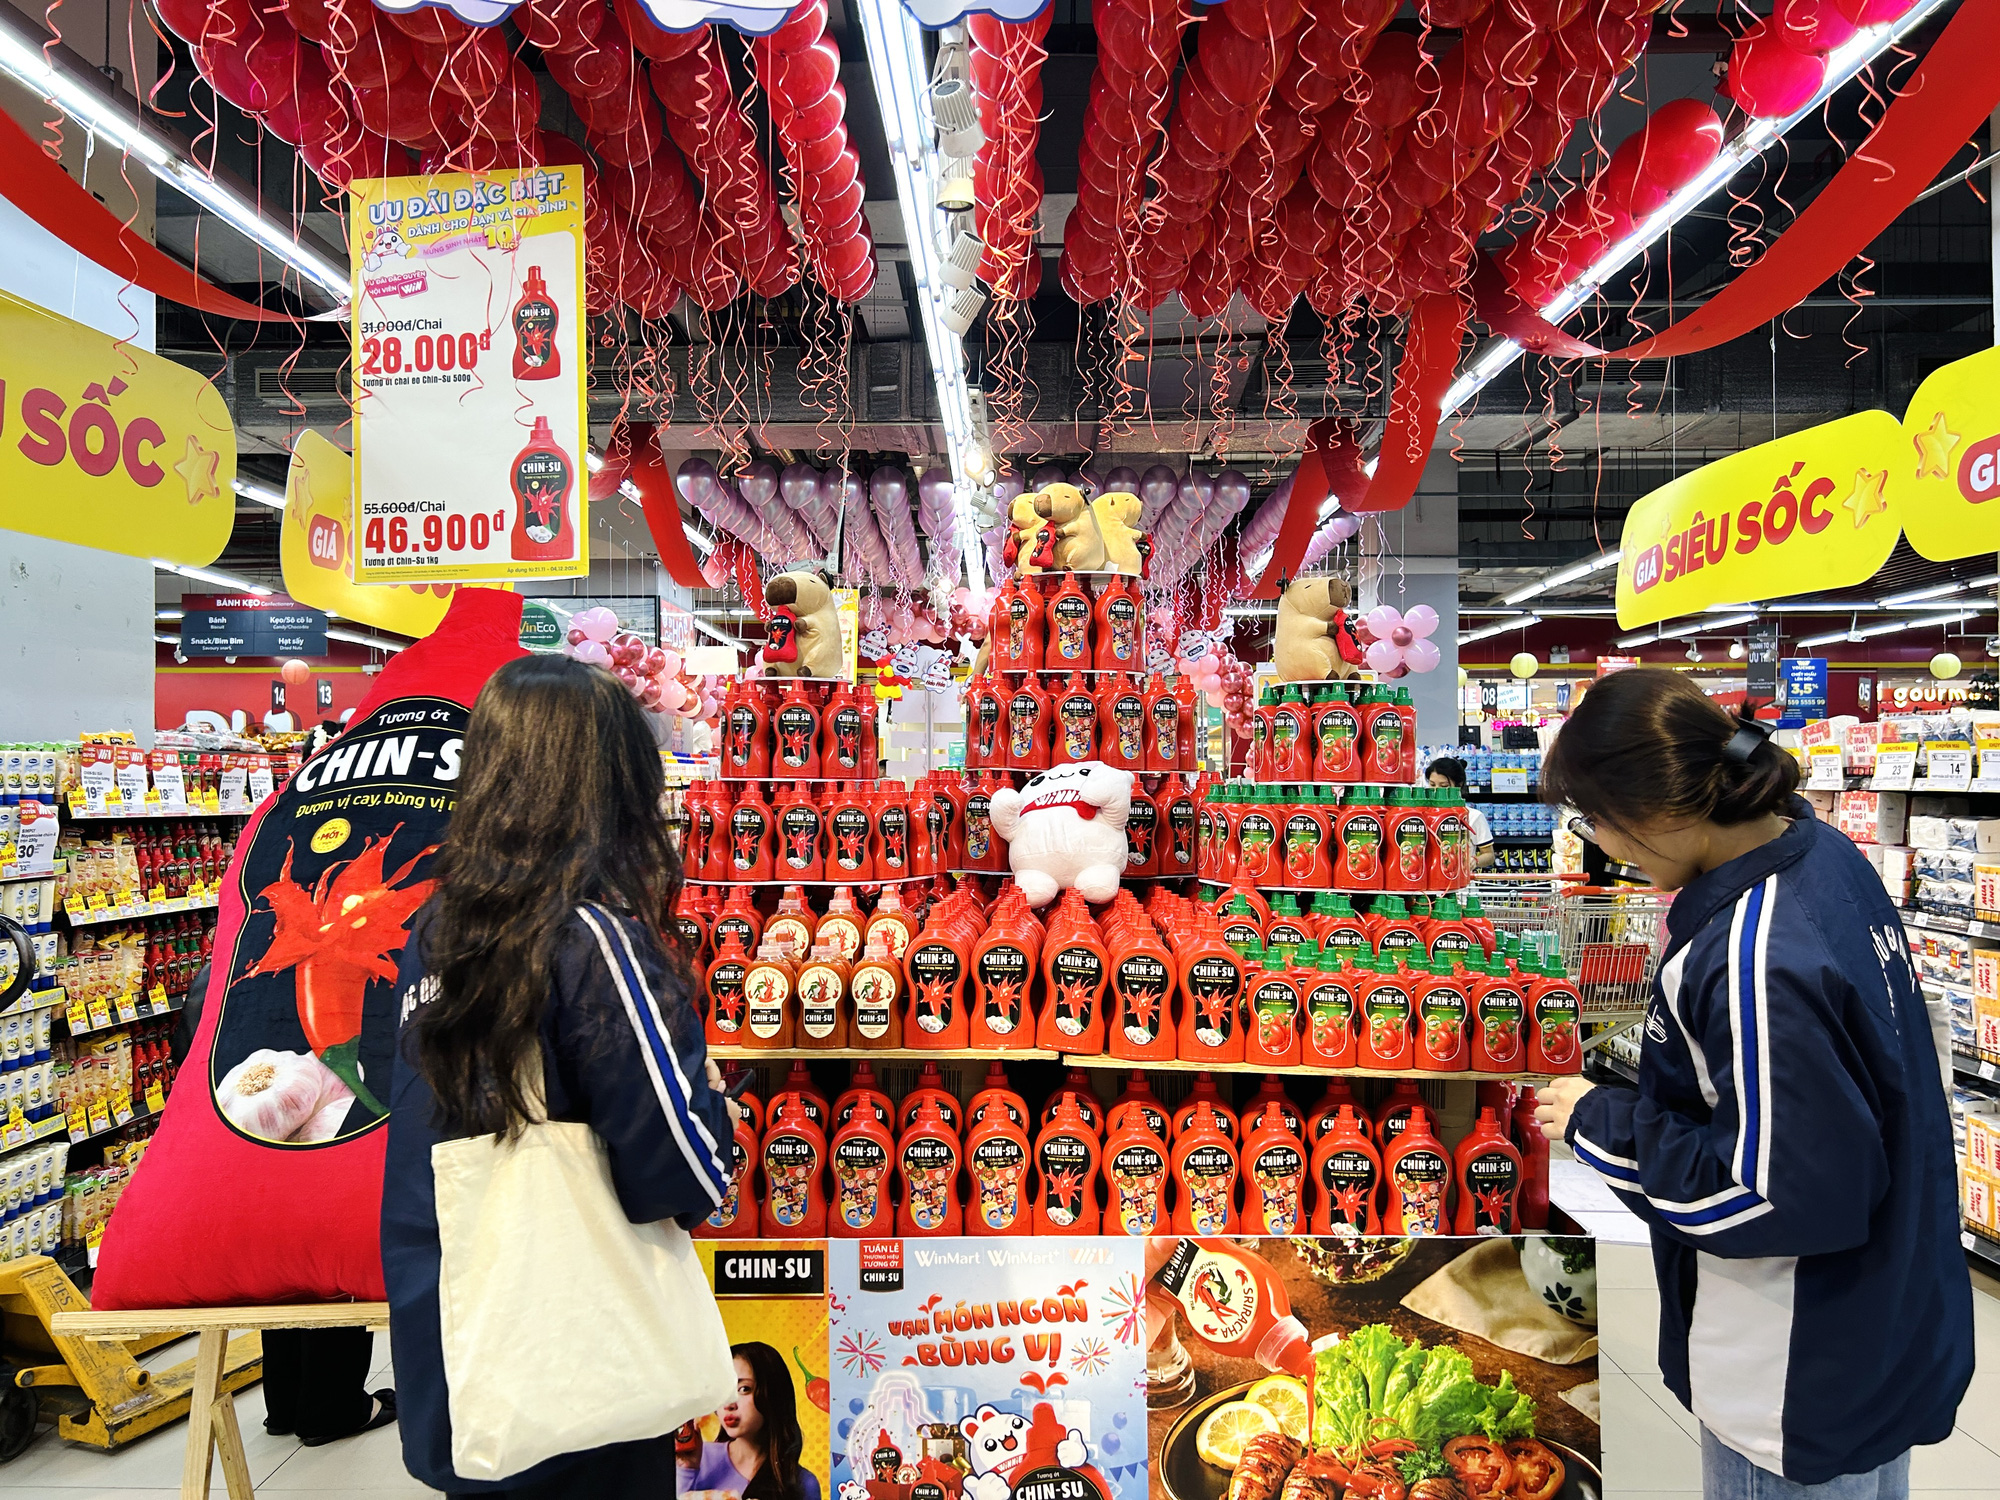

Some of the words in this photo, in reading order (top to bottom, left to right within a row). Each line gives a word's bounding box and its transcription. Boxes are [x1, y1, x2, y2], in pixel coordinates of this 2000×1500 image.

[369, 200, 403, 225] ƯU
[407, 188, 450, 219] ĐÃI
[454, 182, 505, 213] ĐẶC
[511, 170, 565, 202] BIỆT
[408, 221, 440, 238] DÀNH
[442, 217, 473, 232] CHO
[471, 213, 495, 228] BẠN
[497, 208, 512, 222] VÀ
[536, 200, 568, 214] ĐÌNH
[445, 241, 462, 252] SINH
[483, 225, 513, 250] 10
[375, 275, 387, 285] ĐÃI
[387, 274, 402, 283] ĐẶC
[402, 270, 427, 281] QUYỀN
[382, 285, 397, 293] VIÊN
[520, 307, 551, 317] CHIN-SU
[362, 329, 491, 376] 28.000đ
[362, 377, 384, 388] Tương
[394, 375, 410, 386] chai
[411, 377, 421, 385] eo
[422, 375, 451, 385] Chin-Su
[453, 373, 471, 385] 500g
[18, 375, 166, 488] SỐC
[521, 461, 562, 474] CHIN-SU
[364, 500, 446, 515] 55.600đ/Chai
[1637, 548, 1659, 588] GIÁ
[1664, 511, 1731, 583] SIÊU
[1734, 461, 1836, 555] SỐC
[365, 509, 506, 554] 46.900đ
[312, 522, 337, 562] GIÁ
[365, 558, 387, 568] Tương
[387, 557, 395, 566] ớt
[396, 556, 425, 566] Chin-Su
[426, 555, 439, 565] 1kg
[216, 597, 240, 607] BÁNH
[242, 599, 260, 609] KẸO
[208, 616, 227, 624] Bánh
[190, 637, 229, 646] Snack/Bim
[229, 637, 244, 645] Bim
[278, 637, 292, 646] Hạt
[319, 685, 332, 705] 13
[1790, 683, 1819, 696] 3,5%
[1858, 682, 1870, 702] 05
[274, 686, 286, 706] 14
[1482, 688, 1496, 706] 08
[1557, 689, 1569, 707] 07
[1012, 701, 1035, 710] CHIN-SU
[1117, 702, 1141, 711] CHIN-SU
[378, 708, 426, 727] Tương
[430, 708, 450, 722] ớt
[837, 714, 860, 723] CHIN-SU
[296, 735, 464, 793] CHIN-S
[1950, 763, 1960, 775] 14
[1826, 767, 1833, 778] 31
[1892, 765, 1902, 776] 23
[1507, 778, 1516, 786] 16
[85, 786, 97, 799] 19
[121, 788, 132, 800] 19
[159, 788, 170, 800] 18
[220, 788, 230, 800] 18
[253, 788, 263, 799] 54
[295, 796, 334, 819] Đượm
[337, 795, 351, 811] vị
[353, 792, 382, 807] cay,
[384, 792, 425, 810] bùng
[430, 795, 445, 812] vị
[733, 813, 761, 823] CHIN-SU
[836, 813, 866, 823] CHIN-SU
[1242, 821, 1270, 831] CHIN-SU
[1347, 821, 1378, 832] CHIN-SU
[320, 829, 340, 842] MỚI
[18, 844, 35, 858] 30
[1270, 931, 1302, 943] CHIN-SU
[1384, 936, 1416, 947] CHIN-SU
[915, 953, 955, 965] CHIN-SU
[1057, 954, 1098, 969] CHIN-SU
[1312, 991, 1348, 1003] CHIN-SU
[1426, 995, 1461, 1006] CHIN-SU
[1541, 997, 1575, 1009] CHIN-SU
[805, 1013, 833, 1023] CHIN-SU
[908, 1146, 947, 1158] CHIN-SU
[978, 1145, 1018, 1157] CHIN-SU
[1189, 1154, 1228, 1166] CHIN-SU
[1327, 1158, 1370, 1171] CHIN-SU
[863, 1243, 888, 1253] TUẦN
[888, 1242, 899, 1253] LỄ
[863, 1260, 889, 1268] TƯƠNG
[889, 1259, 899, 1268] ỚT
[914, 1250, 981, 1268] WinMart
[724, 1257, 812, 1280] CHIN-SU
[863, 1273, 899, 1283] CHIN-SU
[888, 1317, 930, 1340] VẠN
[933, 1300, 994, 1333] MÓN
[997, 1296, 1088, 1327] NGON
[1221, 1287, 1254, 1338] SRIRACHA
[917, 1335, 1015, 1368] BÙNG
[1023, 1332, 1062, 1368] VỊ
[875, 1451, 896, 1460] CHIN-SU
[1036, 1472, 1053, 1480] Tương
[915, 1487, 940, 1496] CHIN-SU
[1015, 1480, 1084, 1500] CHIN-SU
